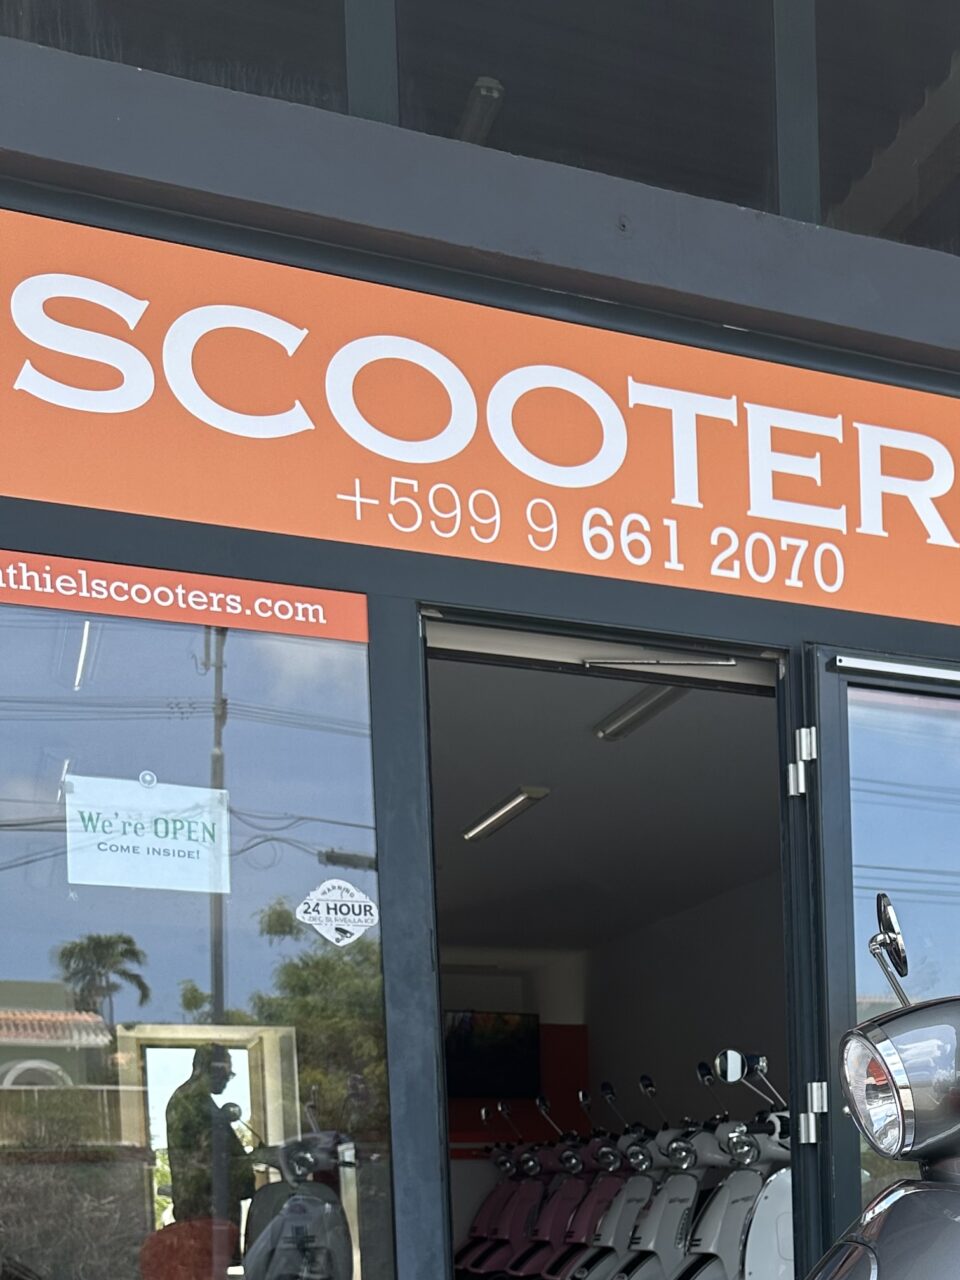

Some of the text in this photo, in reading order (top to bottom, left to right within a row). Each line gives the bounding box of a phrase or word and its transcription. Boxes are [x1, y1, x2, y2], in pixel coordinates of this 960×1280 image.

[336, 476, 845, 593] +599 9 661 2070
[0, 561, 327, 624] thielscooters.com
[78, 810, 217, 844] We're OPEN
[303, 902, 374, 917] 24 HOUR
